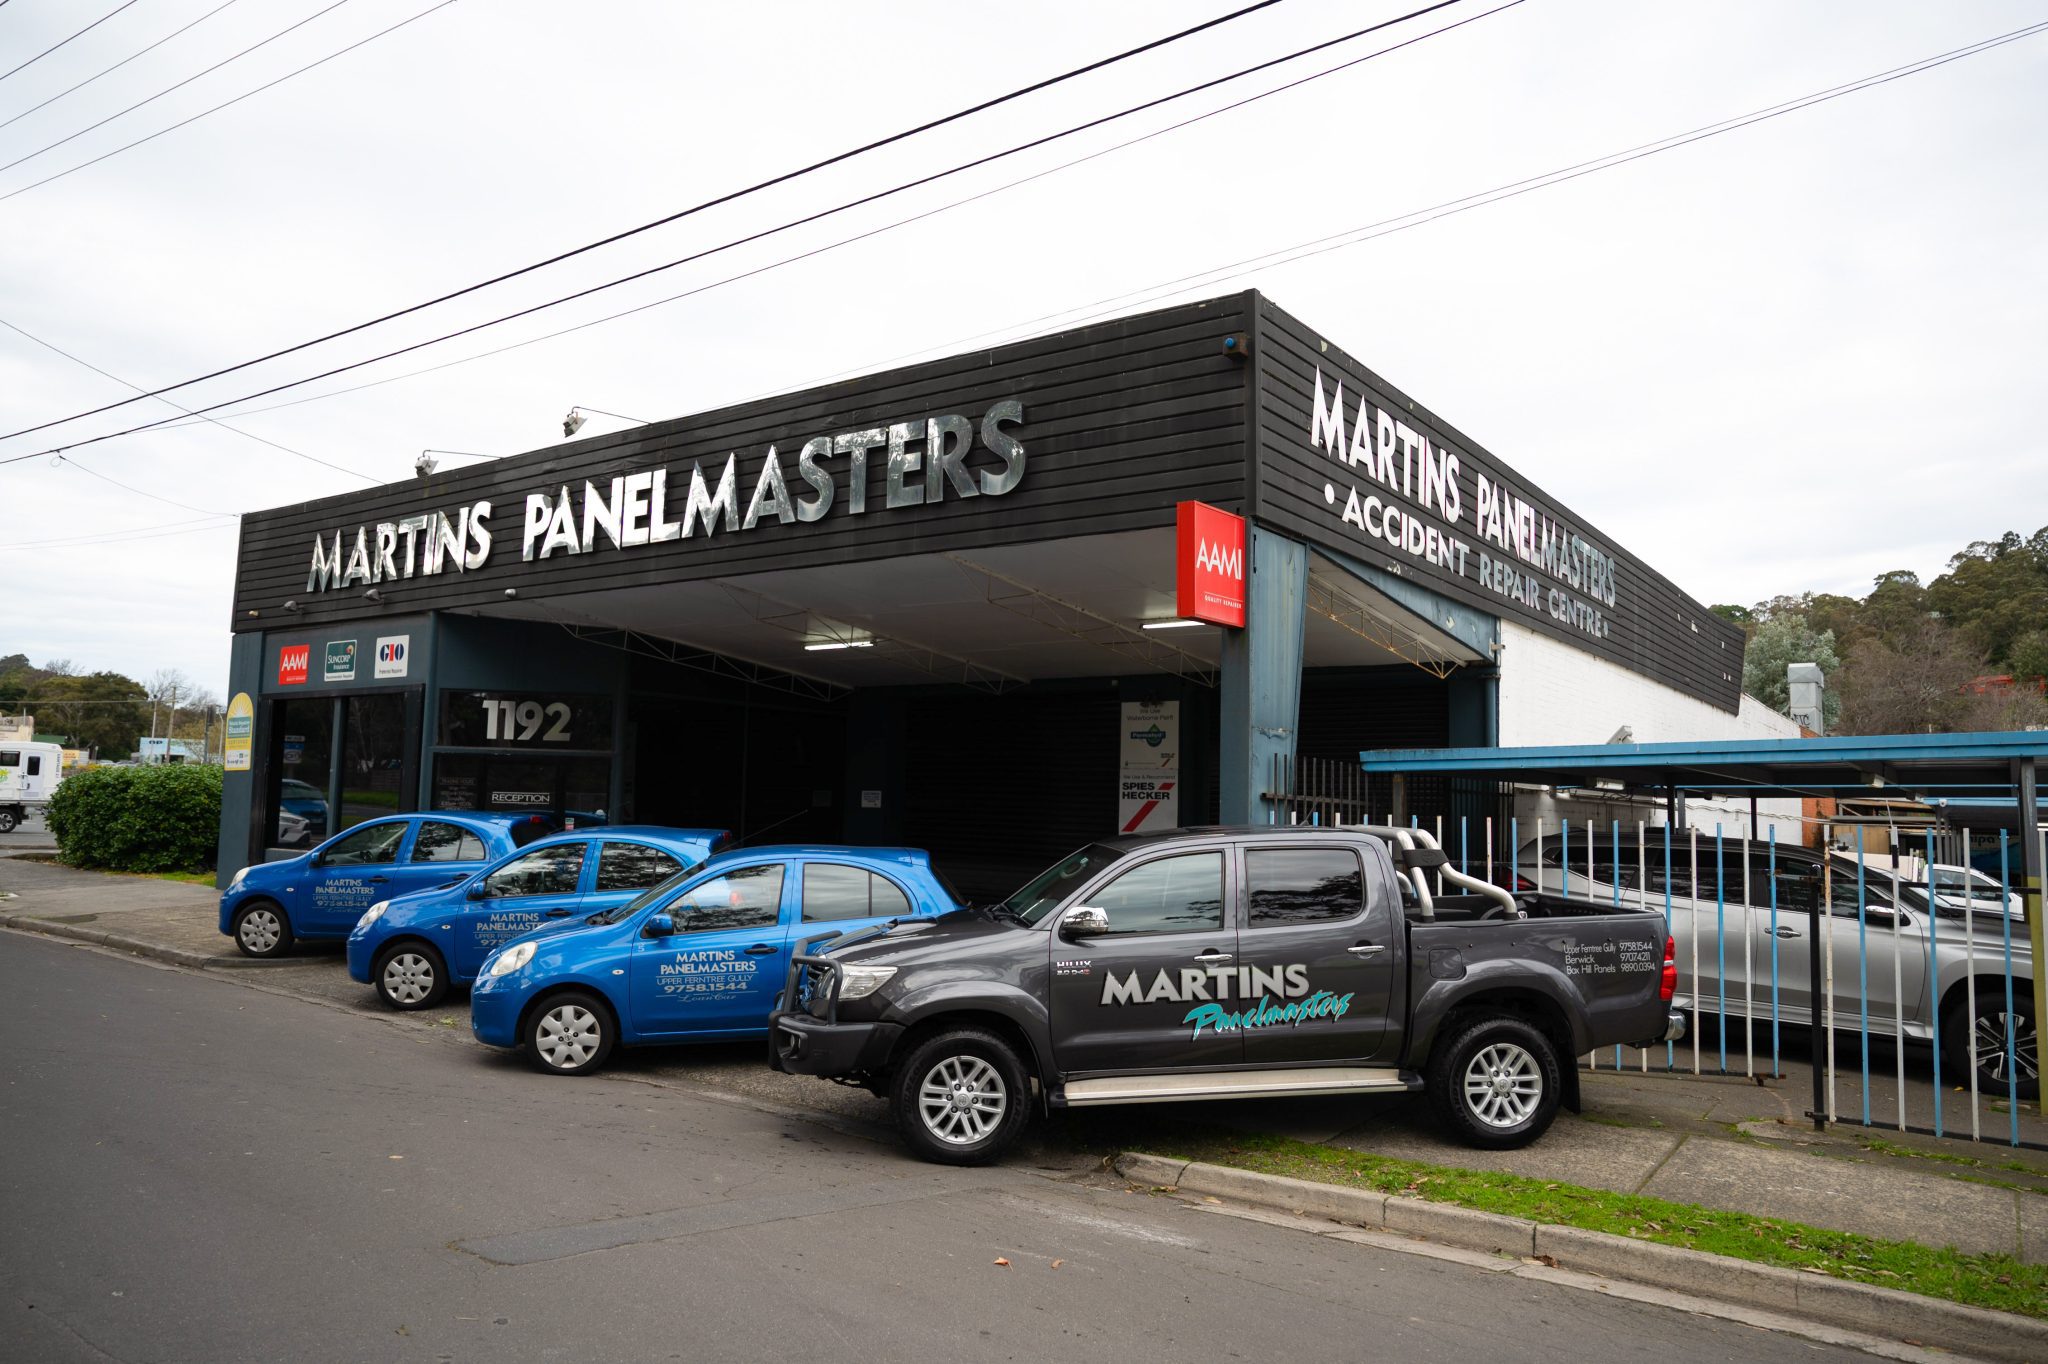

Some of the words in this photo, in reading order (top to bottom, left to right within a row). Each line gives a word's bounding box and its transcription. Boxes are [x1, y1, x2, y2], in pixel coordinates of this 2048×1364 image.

[1310, 363, 1461, 524] MARTINS
[1476, 471, 1616, 608] PANELMASTERS
[306, 500, 492, 593] MARTINS
[522, 400, 1027, 562] PANELMASTERS
[1196, 536, 1242, 581] AAMI
[1342, 485, 1470, 577] ACCIDENT
[1479, 552, 1541, 611] REPAIR
[1549, 588, 1602, 638] CENTRE
[380, 643, 404, 663] GIO
[281, 652, 308, 672] AAMI
[482, 700, 572, 742] 1192
[1122, 782, 1155, 790] SPIES
[491, 793, 550, 803] RECEPTION
[1122, 791, 1170, 800] HECKER
[315, 886, 375, 894] PANELMASTERS
[490, 912, 539, 922] MARTINS
[1563, 944, 1580, 955] Upper
[1603, 942, 1616, 954] Gully
[676, 950, 735, 963] MARTINS
[1566, 955, 1595, 964] Berwick
[660, 961, 756, 975] PANELMASTERS
[1567, 965, 1579, 975] Box
[1594, 963, 1616, 974] Panels
[656, 976, 682, 986] UPPER
[684, 975, 725, 984] FERNTREE
[727, 974, 754, 982] GULLY
[1101, 963, 1311, 1006] MARTINS
[664, 982, 747, 993] 9758.1544
[1182, 989, 1355, 1041] Panelmasters
